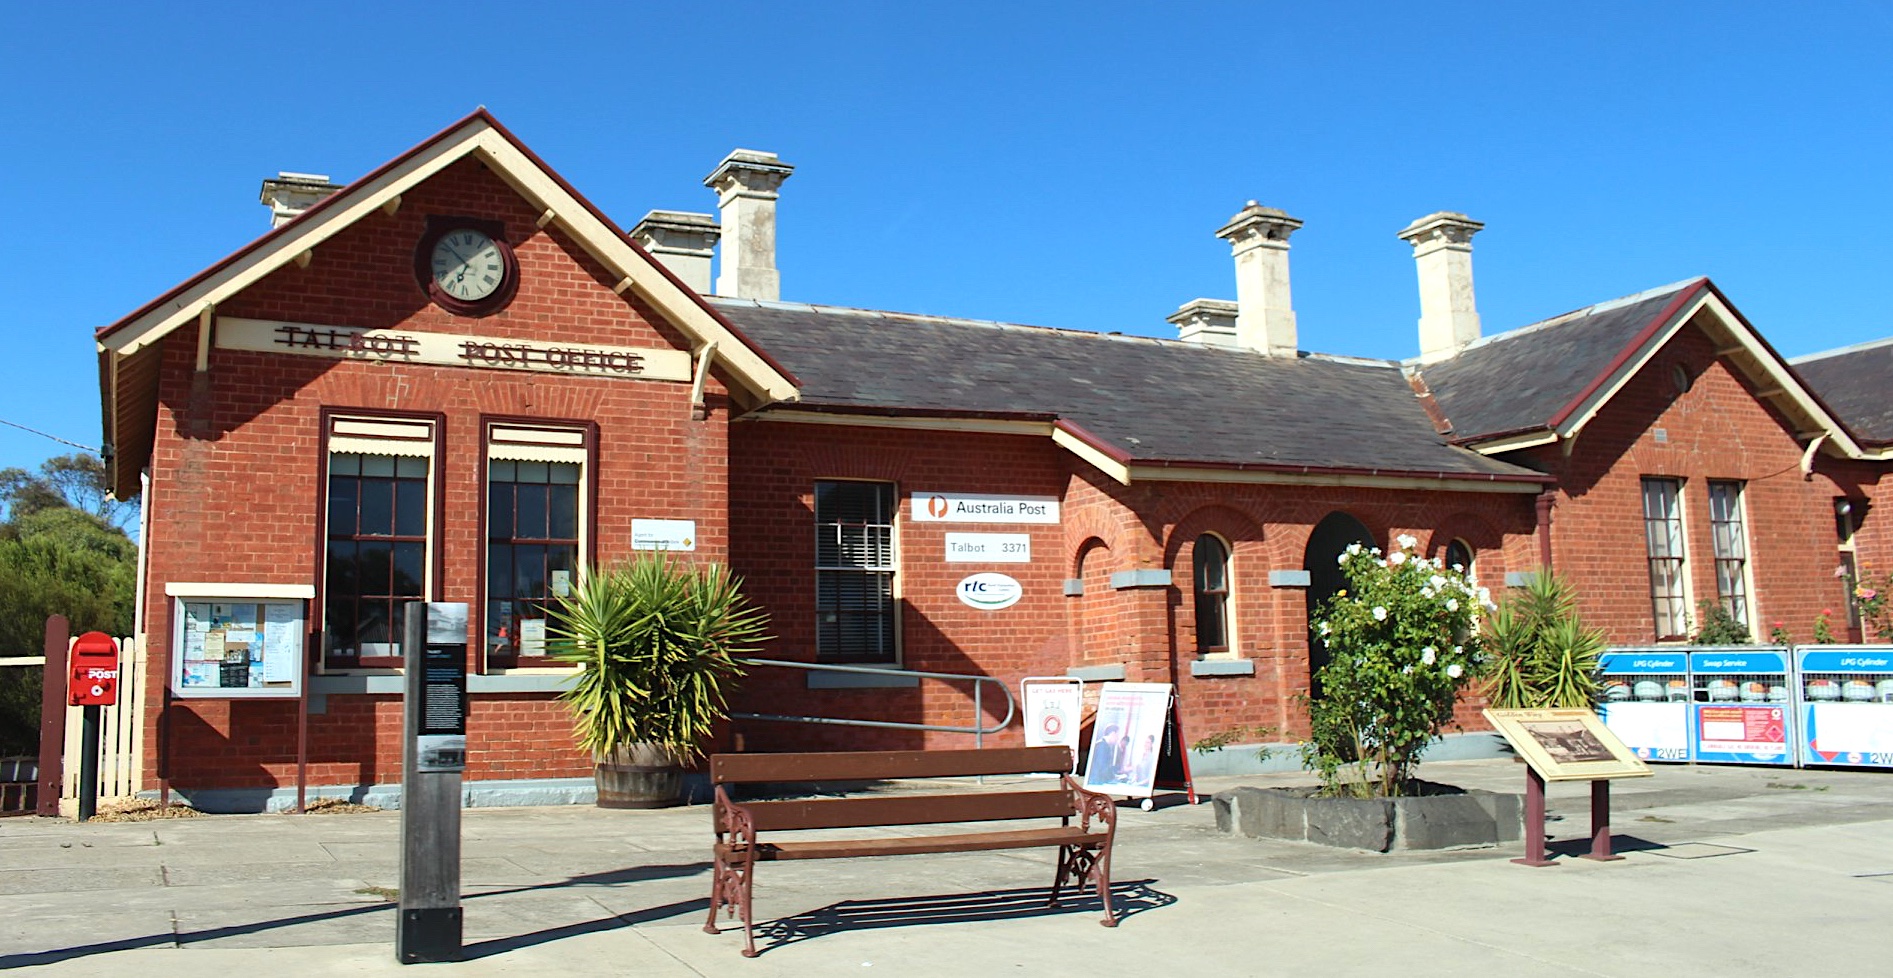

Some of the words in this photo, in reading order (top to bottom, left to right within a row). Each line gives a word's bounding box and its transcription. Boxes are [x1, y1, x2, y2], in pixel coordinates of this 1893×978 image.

[282, 326, 413, 354] TALBOT
[465, 341, 532, 365] POST
[546, 347, 641, 373] OFFICE
[956, 501, 1014, 515] Australia
[1019, 502, 1047, 516] Post
[950, 542, 986, 553] Talbot
[1002, 543, 1027, 553] 3371
[1647, 660, 1675, 669] Cylinder
[1703, 659, 1722, 668] Swap
[1840, 658, 1856, 666] LPG
[1856, 658, 1888, 667] Cylinder
[88, 670, 118, 679] POST
[1658, 748, 1687, 760] 2WE
